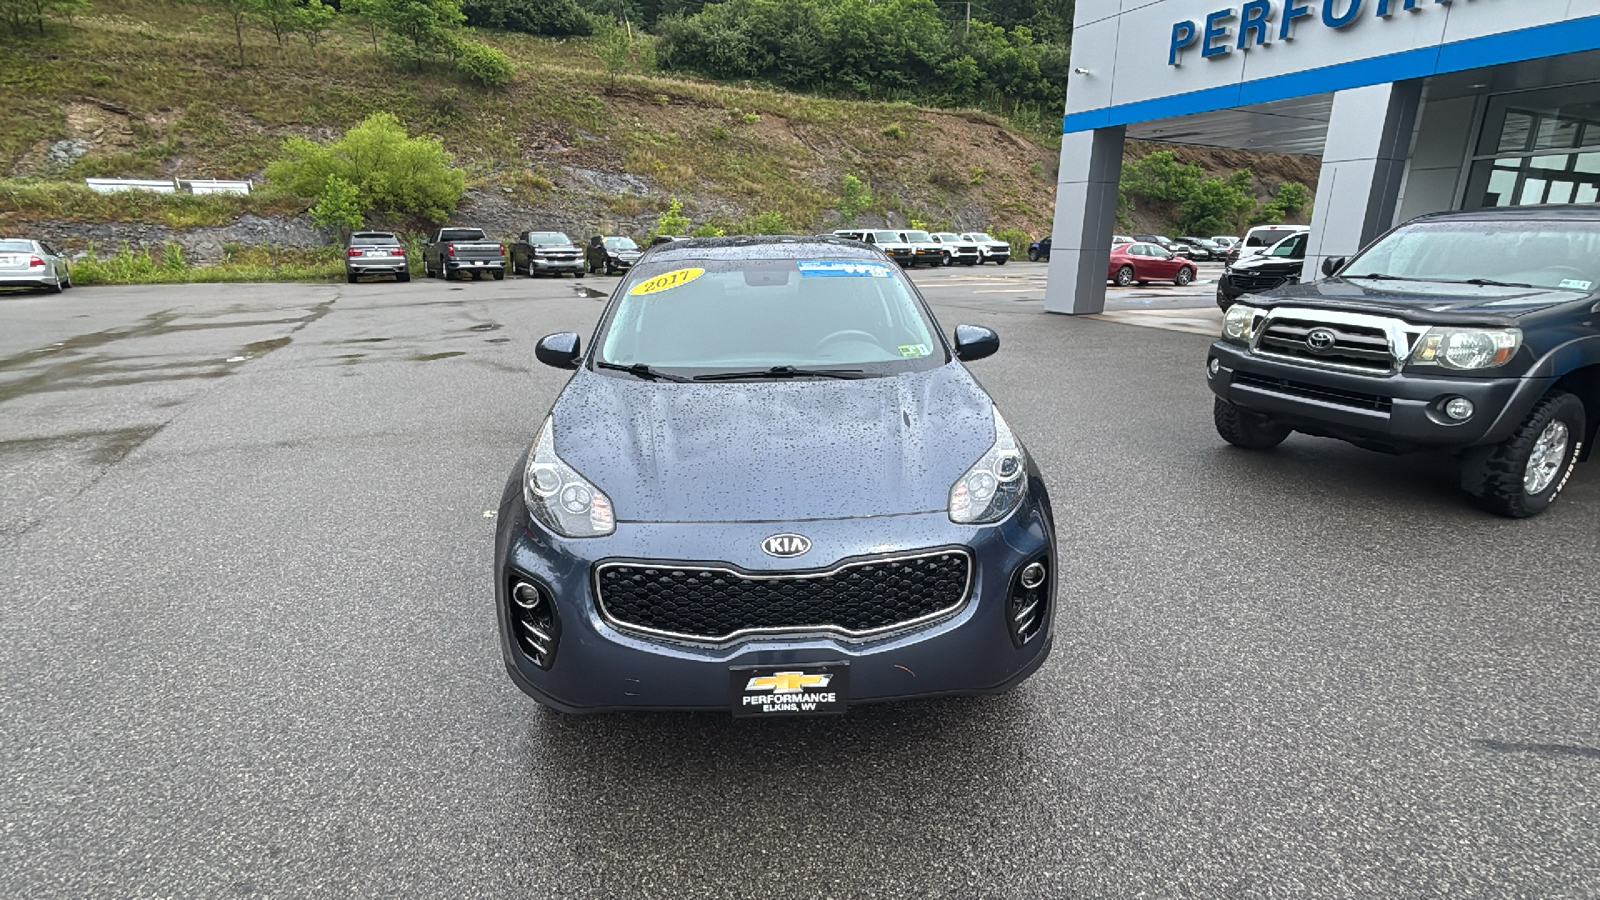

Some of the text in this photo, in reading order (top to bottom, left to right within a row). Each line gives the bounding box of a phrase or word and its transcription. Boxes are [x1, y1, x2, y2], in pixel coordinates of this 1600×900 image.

[1168, 0, 1445, 67] PERFO
[644, 271, 689, 292] 2017
[770, 538, 804, 553] KIA
[742, 692, 836, 705] PERFORMANCE
[763, 702, 816, 712] ELKINS, WV
